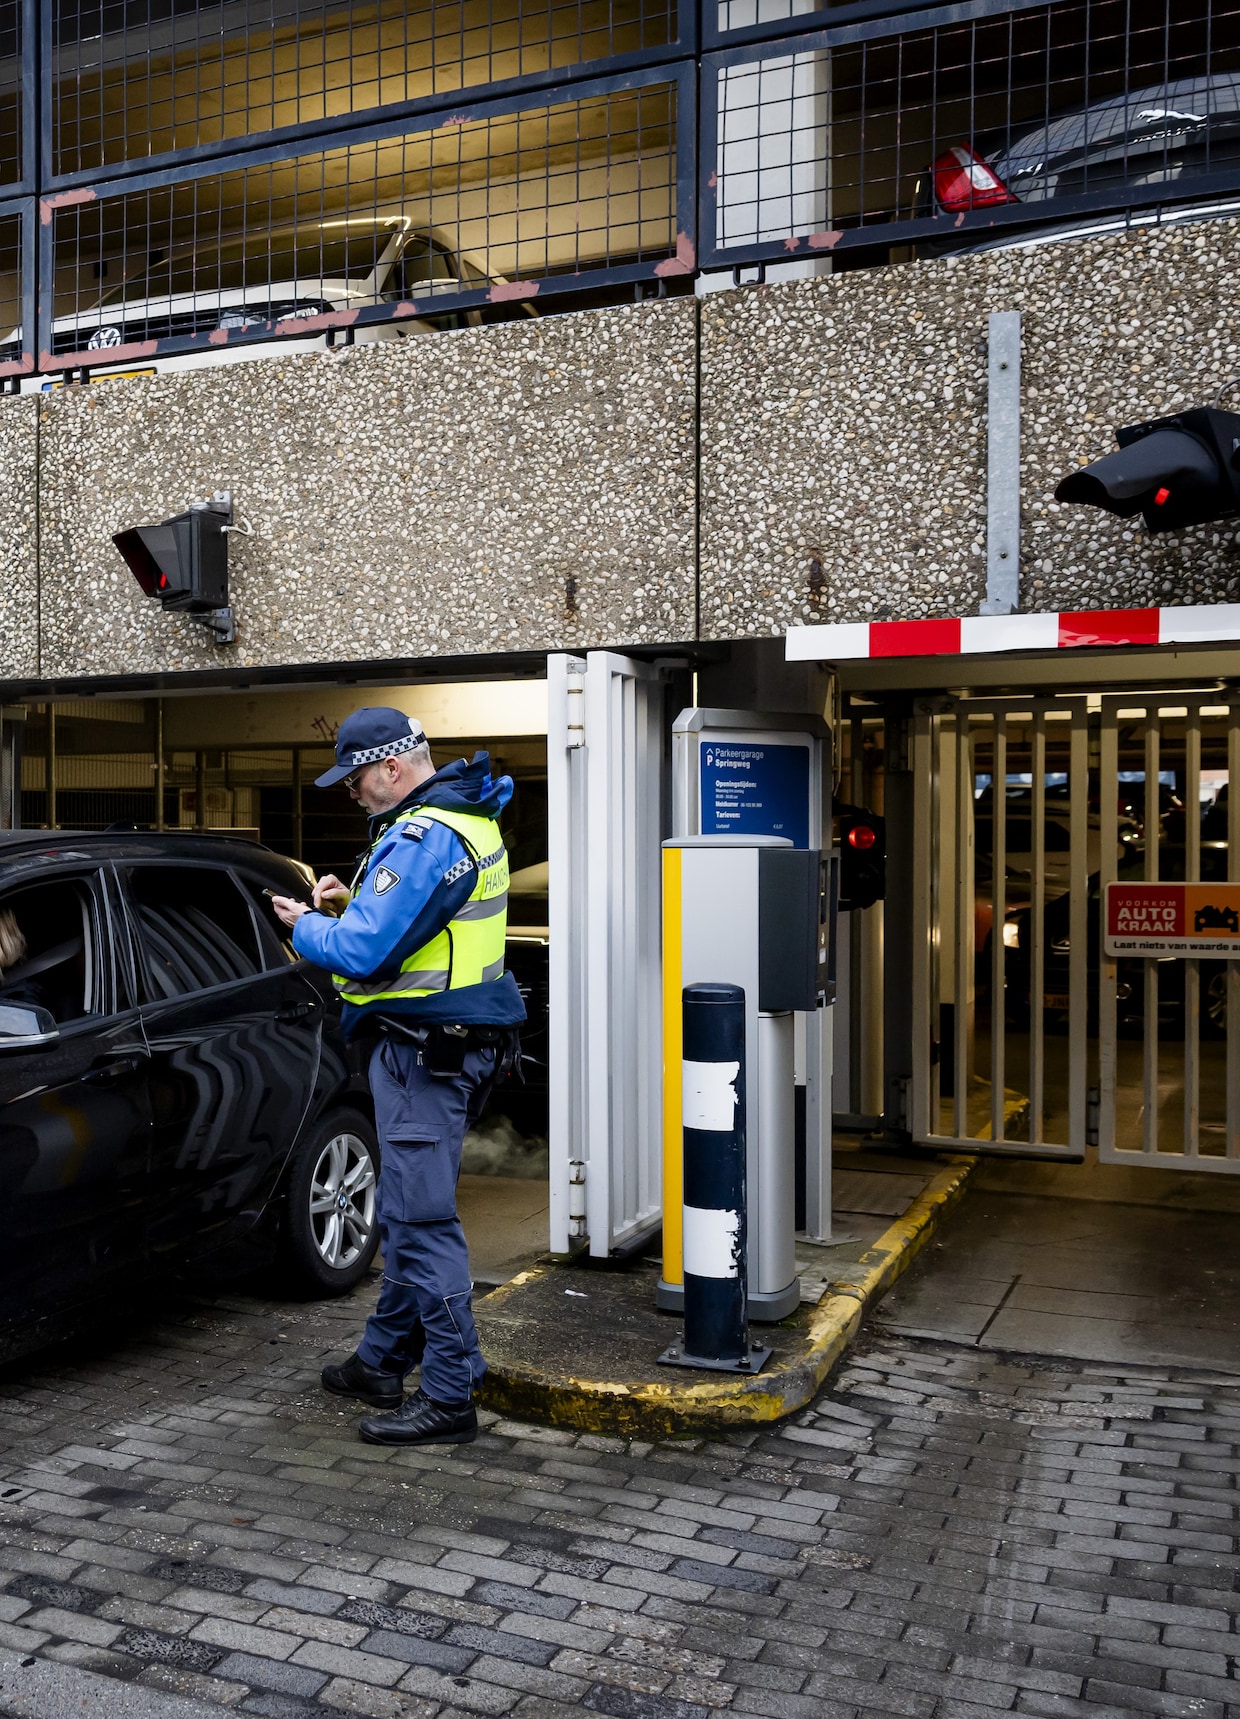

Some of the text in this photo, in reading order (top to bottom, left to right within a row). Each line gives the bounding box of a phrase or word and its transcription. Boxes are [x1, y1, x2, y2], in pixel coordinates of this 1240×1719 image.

[715, 748, 764, 761] Parkeergarage
[707, 755, 751, 769] P Springweg
[1118, 907, 1176, 920] AUTO
[1118, 921, 1175, 931] KRAAK
[1114, 941, 1136, 949] Laat
[1190, 943, 1229, 951] waarde
